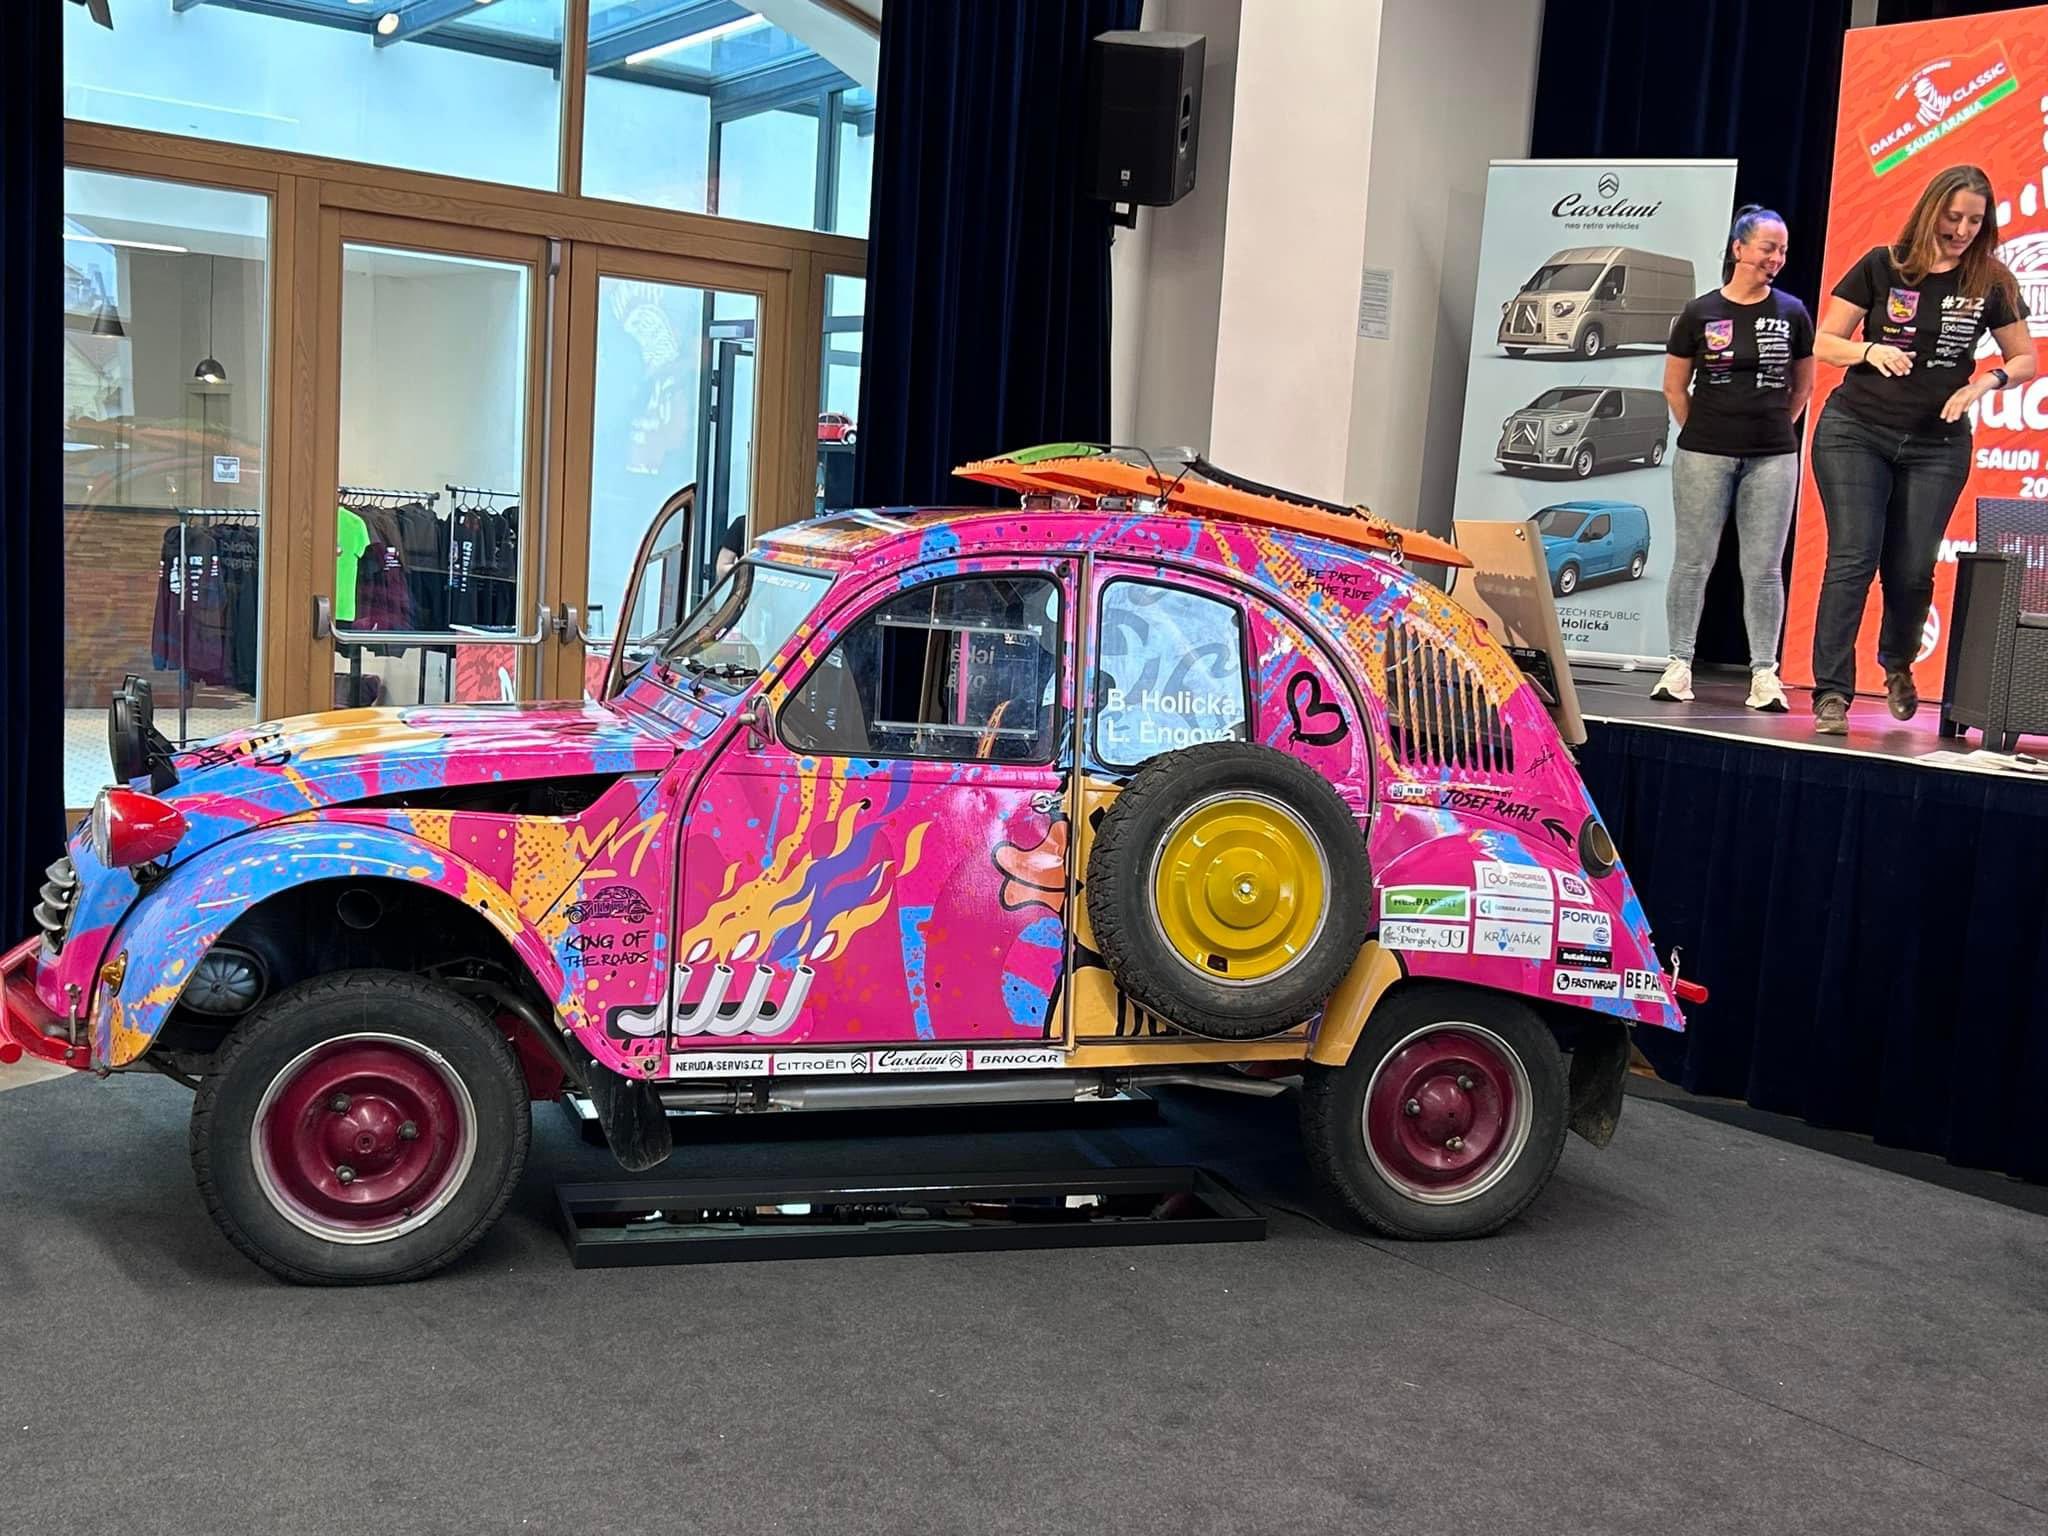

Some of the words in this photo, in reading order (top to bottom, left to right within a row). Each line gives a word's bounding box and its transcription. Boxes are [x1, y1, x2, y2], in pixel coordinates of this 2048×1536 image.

[1952, 62, 2006, 102] CLASSIC
[1906, 128, 1941, 156] SAUDI
[1940, 100, 1984, 134] ARABIA
[1870, 121, 1912, 156] DAKAR
[1551, 192, 1662, 218] Caselani
[1564, 222, 1581, 230] neo
[1582, 222, 1604, 230] retro
[1606, 222, 1640, 230] vehicles
[1941, 295, 1985, 311] #712
[1755, 317, 1790, 334] #712
[1976, 447, 2040, 471] SAUDI
[1306, 568, 1325, 579] BE
[1328, 570, 1361, 585] PART
[1312, 582, 1341, 595] THE
[1342, 587, 1374, 601] RIDE
[1589, 609, 1641, 621] REPUBLIC
[1561, 618, 1609, 631] Holická
[1107, 688, 1132, 713] B.
[1107, 719, 1130, 743] L.
[1440, 789, 1492, 811] JOSEF
[1493, 799, 1541, 822] RATAJ
[1562, 911, 1609, 926] FORVIA
[564, 933, 615, 952] KING
[622, 930, 650, 948] OF
[563, 954, 600, 968] THE
[601, 950, 650, 967] ROADS
[1571, 977, 1618, 991] FASTWRAP
[1626, 971, 1642, 989] BE
[675, 1059, 764, 1072] NERUDA-SERVIS.CZ
[878, 1049, 948, 1067] Caselani
[980, 1054, 1058, 1064] BRNOCAR
